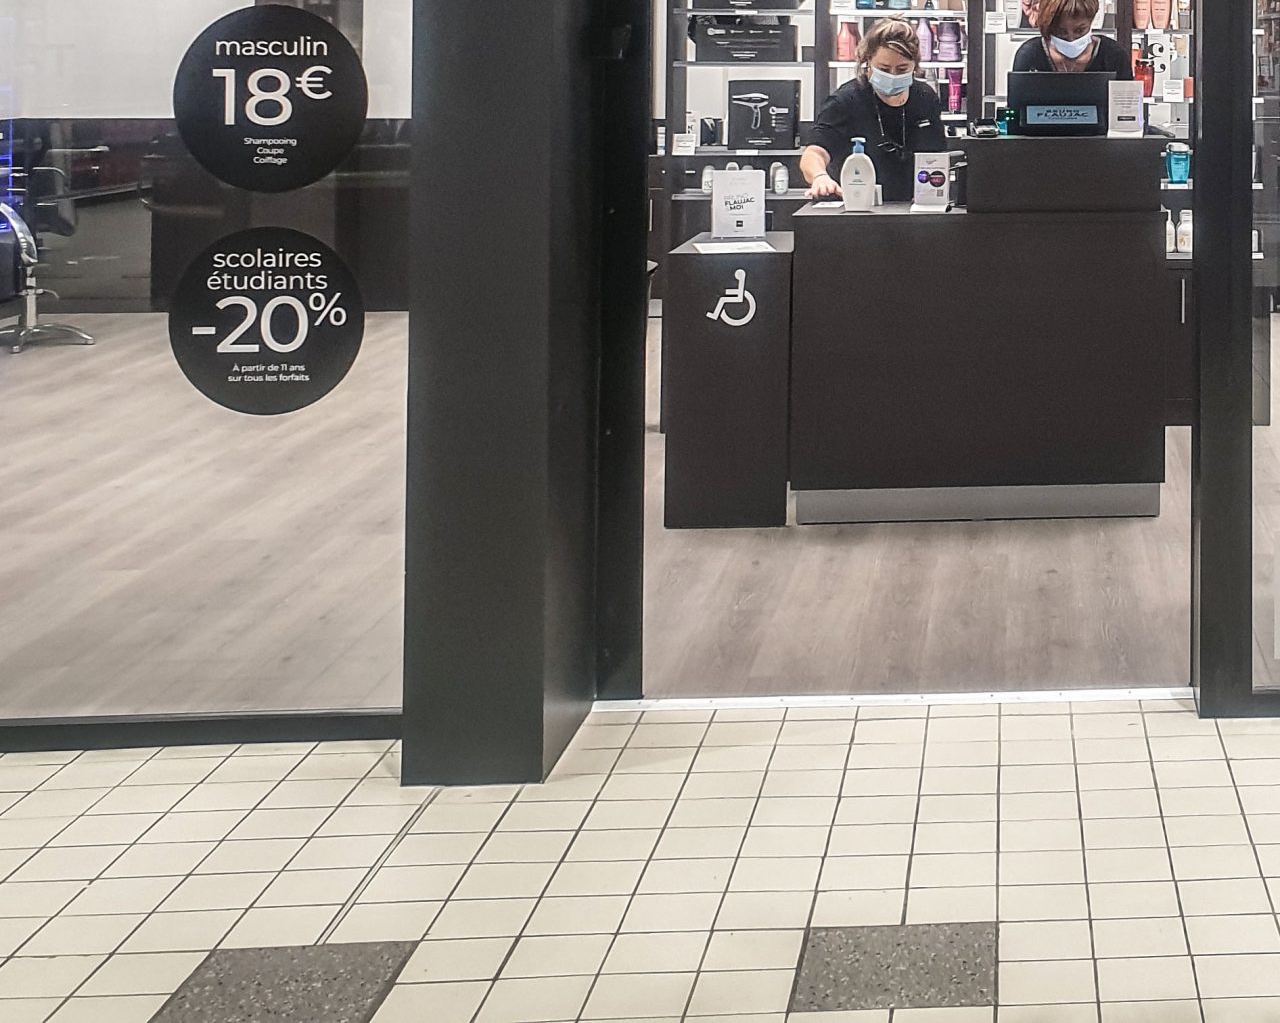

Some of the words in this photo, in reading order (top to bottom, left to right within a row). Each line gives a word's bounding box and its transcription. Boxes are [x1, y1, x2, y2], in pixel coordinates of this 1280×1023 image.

[215, 36, 328, 56] masculin
[212, 65, 333, 126] 18€
[243, 137, 297, 147] Shampooing
[256, 147, 284, 156] Coupe
[253, 156, 288, 165] Coiffage
[213, 248, 322, 268] scolaires
[206, 271, 328, 290] étudiants
[192, 292, 347, 353] -20%
[232, 363, 240, 372] À
[241, 364, 266, 374] partir
[267, 364, 279, 372] de
[281, 364, 288, 372] 11
[244, 374, 264, 382] tous
[265, 374, 278, 382] les
[279, 373, 310, 382] forfaits
